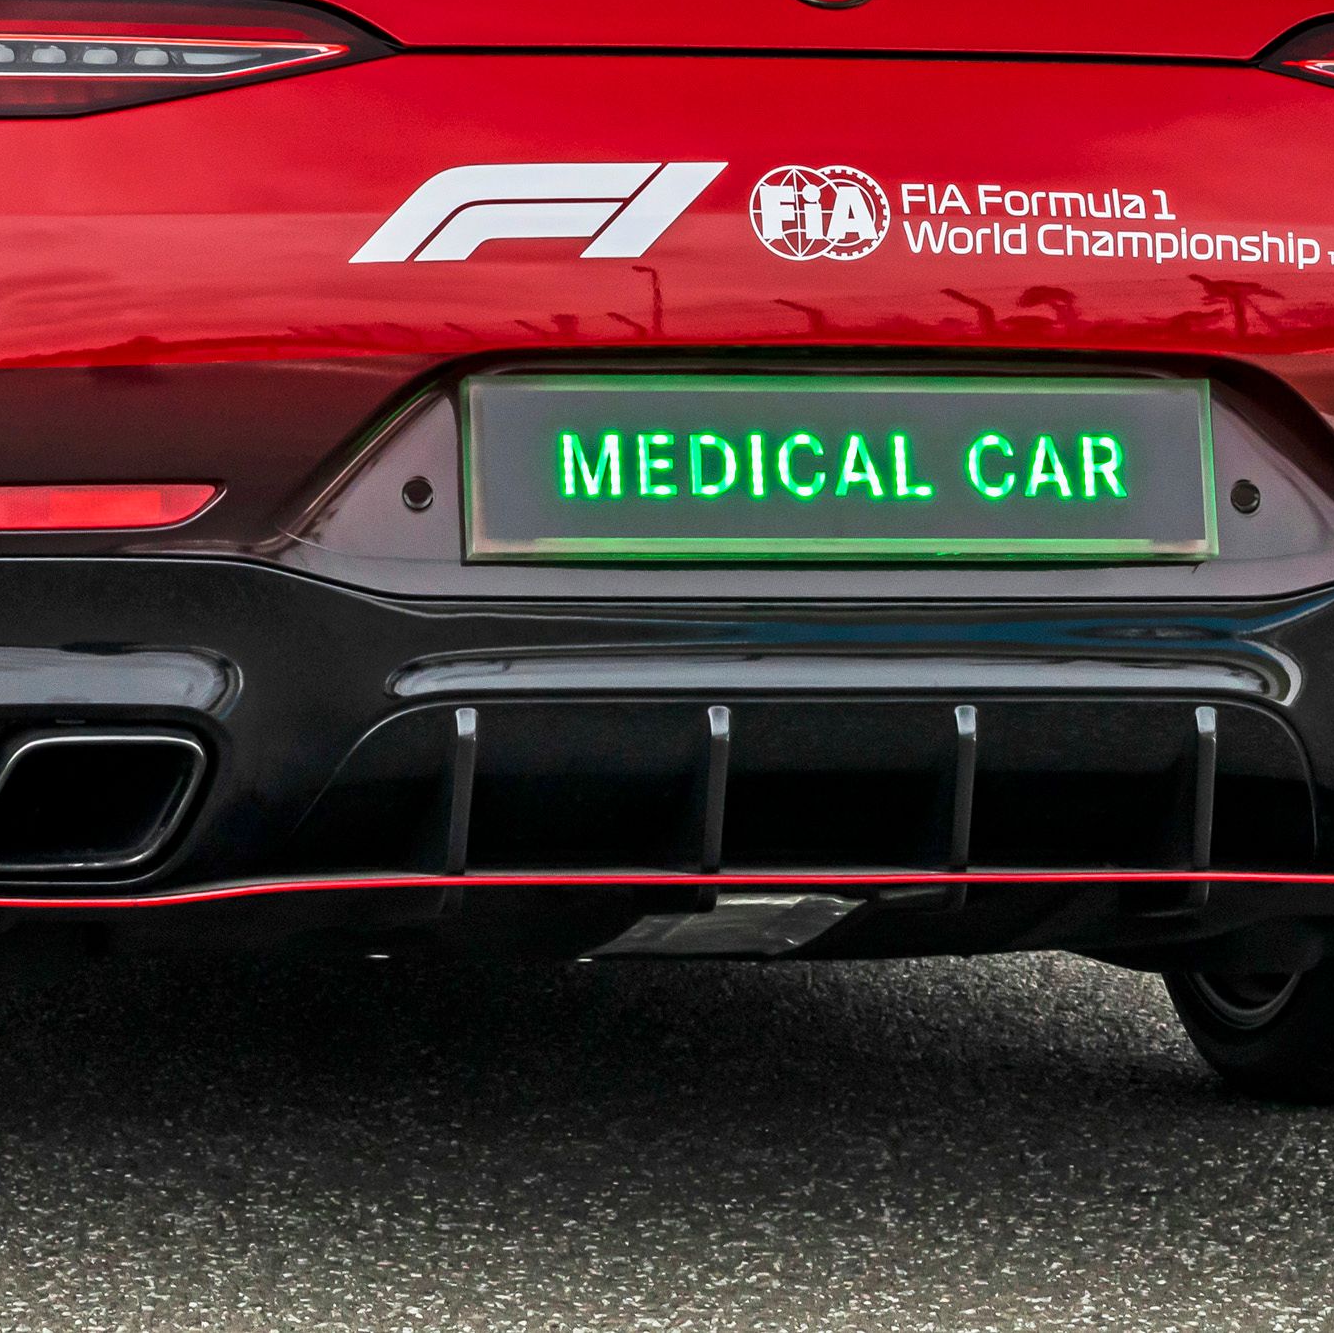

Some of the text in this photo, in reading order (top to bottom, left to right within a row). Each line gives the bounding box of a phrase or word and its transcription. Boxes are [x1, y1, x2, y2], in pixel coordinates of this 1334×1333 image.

[348, 161, 729, 264] F1
[900, 183, 1177, 220] FIA Formula 1
[902, 220, 1028, 256] World
[1037, 223, 1321, 270] Championship
[559, 432, 1129, 499] MEDICAL CAR
